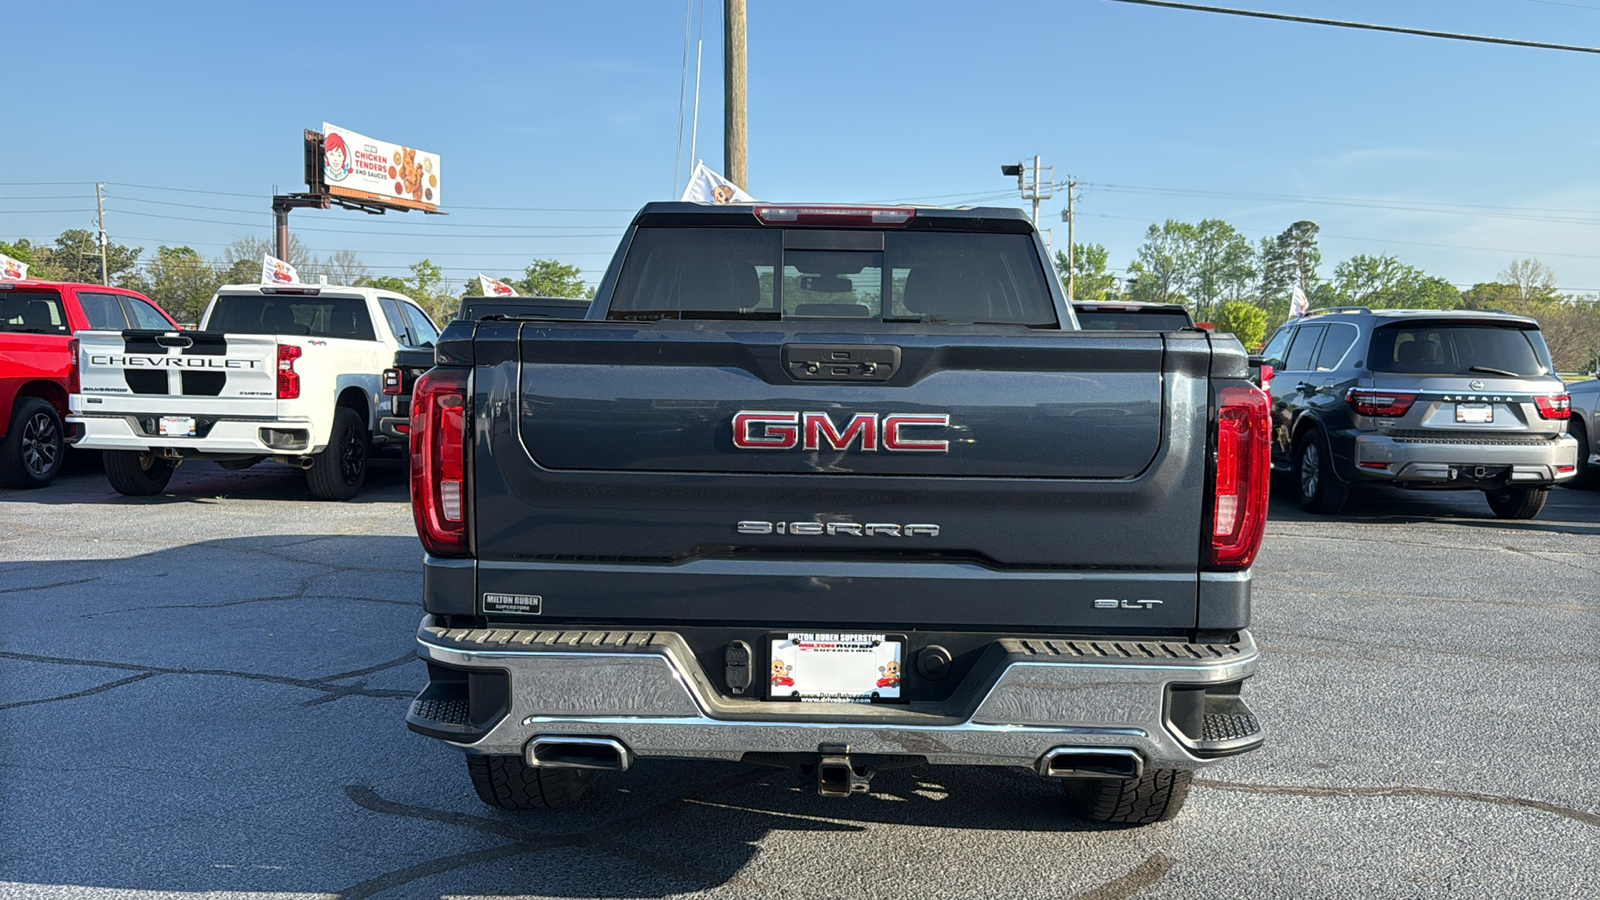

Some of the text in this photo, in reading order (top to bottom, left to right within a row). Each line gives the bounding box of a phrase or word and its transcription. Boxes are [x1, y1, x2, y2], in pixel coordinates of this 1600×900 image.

[355, 150, 387, 164] CHICKEN
[355, 159, 387, 173] TENDERS
[367, 171, 387, 180] SAUCES
[91, 355, 262, 369] CHEVROLET
[732, 410, 950, 452] GMC
[737, 521, 940, 537] SIERRA
[487, 595, 538, 605] MILTON RUBEN
[1094, 599, 1163, 609] SLT
[788, 633, 886, 642] MILTON RUBEN SUPERSTORE
